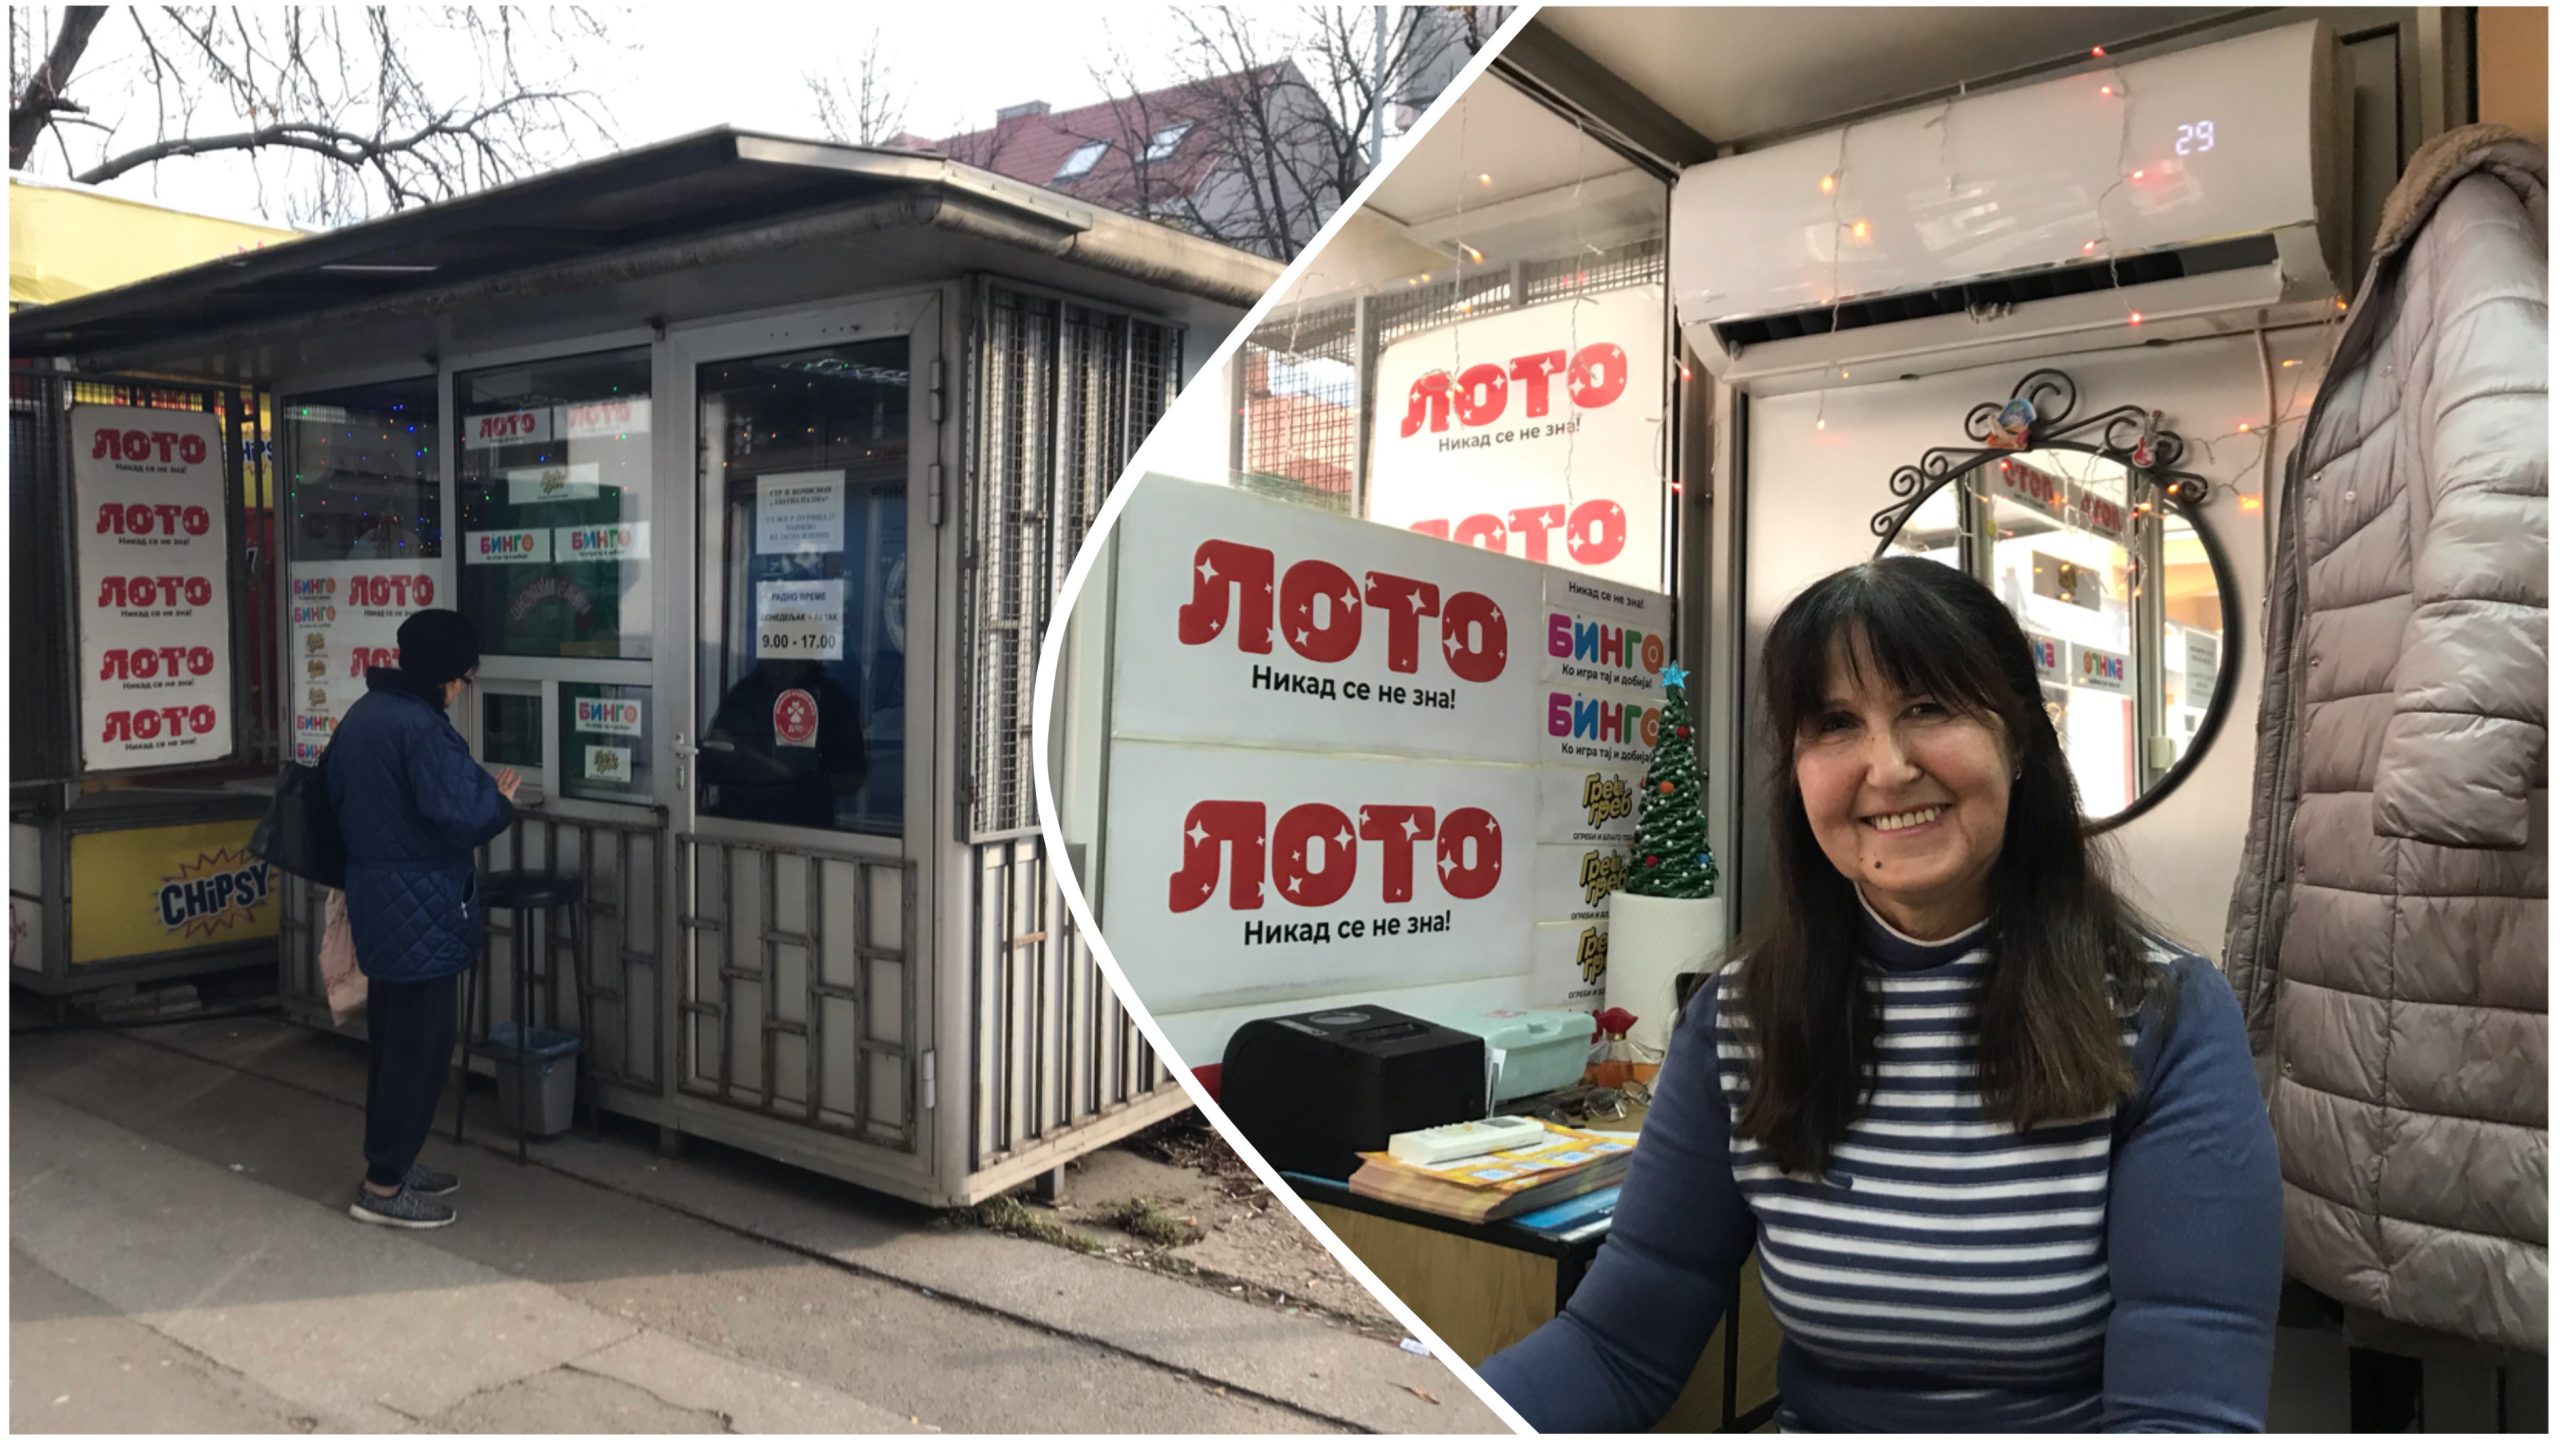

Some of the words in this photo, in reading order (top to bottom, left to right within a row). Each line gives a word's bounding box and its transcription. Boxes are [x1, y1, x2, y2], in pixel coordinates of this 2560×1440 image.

[2176, 120, 2214, 155] 29
[1401, 342, 1627, 438] ЛОТО
[480, 413, 535, 438] ЛОТО
[568, 401, 631, 429] ЛОТО
[92, 428, 206, 464] ЛОТО
[1439, 434, 1491, 453] Никад
[1496, 431, 1514, 444] се
[1520, 426, 1540, 440] не
[1545, 417, 1580, 437] зна!
[96, 503, 210, 536] ЛОТО
[1408, 499, 1626, 565] ОТО
[480, 534, 535, 554] БИНГО
[571, 529, 630, 550] БИНГО
[98, 576, 212, 607] ЛОТО
[294, 577, 336, 594] БИНГО
[348, 574, 434, 607] ЛОТО
[1569, 582, 1600, 600] Никад
[1601, 592, 1612, 601] се
[1613, 594, 1625, 604] не
[1627, 597, 1645, 609] зна!
[121, 609, 149, 618] Никад
[175, 608, 192, 617] зна!
[294, 606, 336, 622] БИНГО
[1178, 539, 1508, 683] ЛОТО
[762, 633, 789, 649] 9.00
[801, 633, 836, 649] 17.00
[1548, 613, 1664, 674] БИНГО
[100, 646, 214, 681] ЛОТО
[350, 647, 400, 678] ЛО
[1562, 664, 1575, 675] Ко
[1577, 669, 1597, 681] игра
[1600, 671, 1612, 685] тај
[1614, 674, 1620, 683] и
[1621, 675, 1652, 689] добија!
[123, 682, 151, 690] Никад
[165, 680, 175, 688] не
[178, 679, 194, 687] зна!
[1252, 664, 1336, 700] Никад
[1343, 680, 1370, 700] се
[1378, 684, 1406, 705] не
[1412, 688, 1456, 710] зна!
[102, 704, 216, 743] ЛОТО
[296, 714, 339, 731] БИНГО
[578, 702, 638, 724] БИНГО
[1548, 692, 1661, 748] БИНГО
[125, 742, 153, 751] Никад
[168, 739, 178, 747] не
[180, 737, 196, 746] зна!
[296, 743, 323, 759] БИН
[1561, 742, 1574, 754] Ко
[1576, 746, 1597, 759] игра
[1599, 748, 1612, 762] тај
[1614, 749, 1619, 759] и
[1621, 749, 1652, 763] добија!
[1169, 800, 1503, 913] ЛОТО
[1244, 919, 1330, 946] Никад
[1337, 919, 1365, 939] се
[1372, 917, 1400, 936] не
[1407, 909, 1451, 934] зна!
[1576, 926, 1608, 965] Гре
